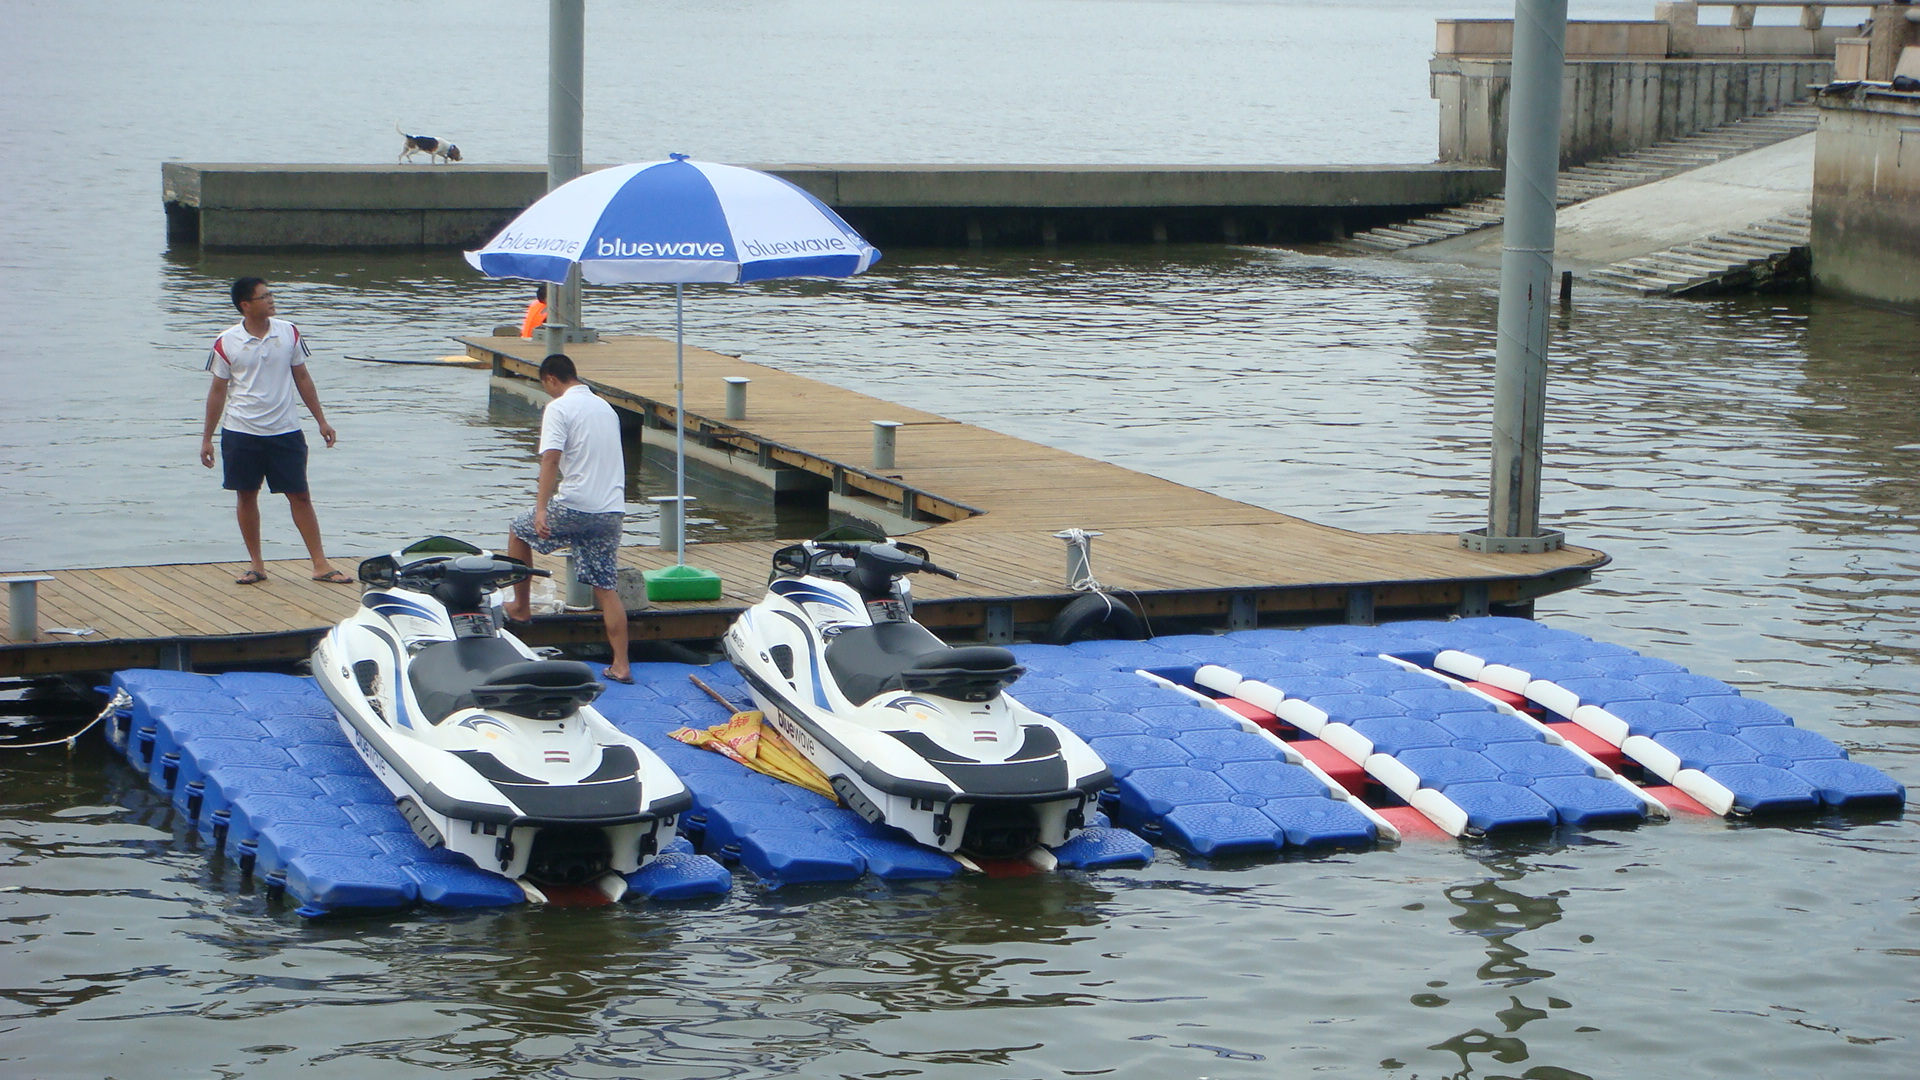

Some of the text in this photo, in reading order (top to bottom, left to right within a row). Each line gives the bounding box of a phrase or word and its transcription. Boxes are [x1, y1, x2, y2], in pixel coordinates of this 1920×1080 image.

[497, 232, 580, 254] bluewave
[597, 237, 726, 257] bluewave
[741, 237, 846, 257] bluewave
[777, 709, 815, 756] bluewave
